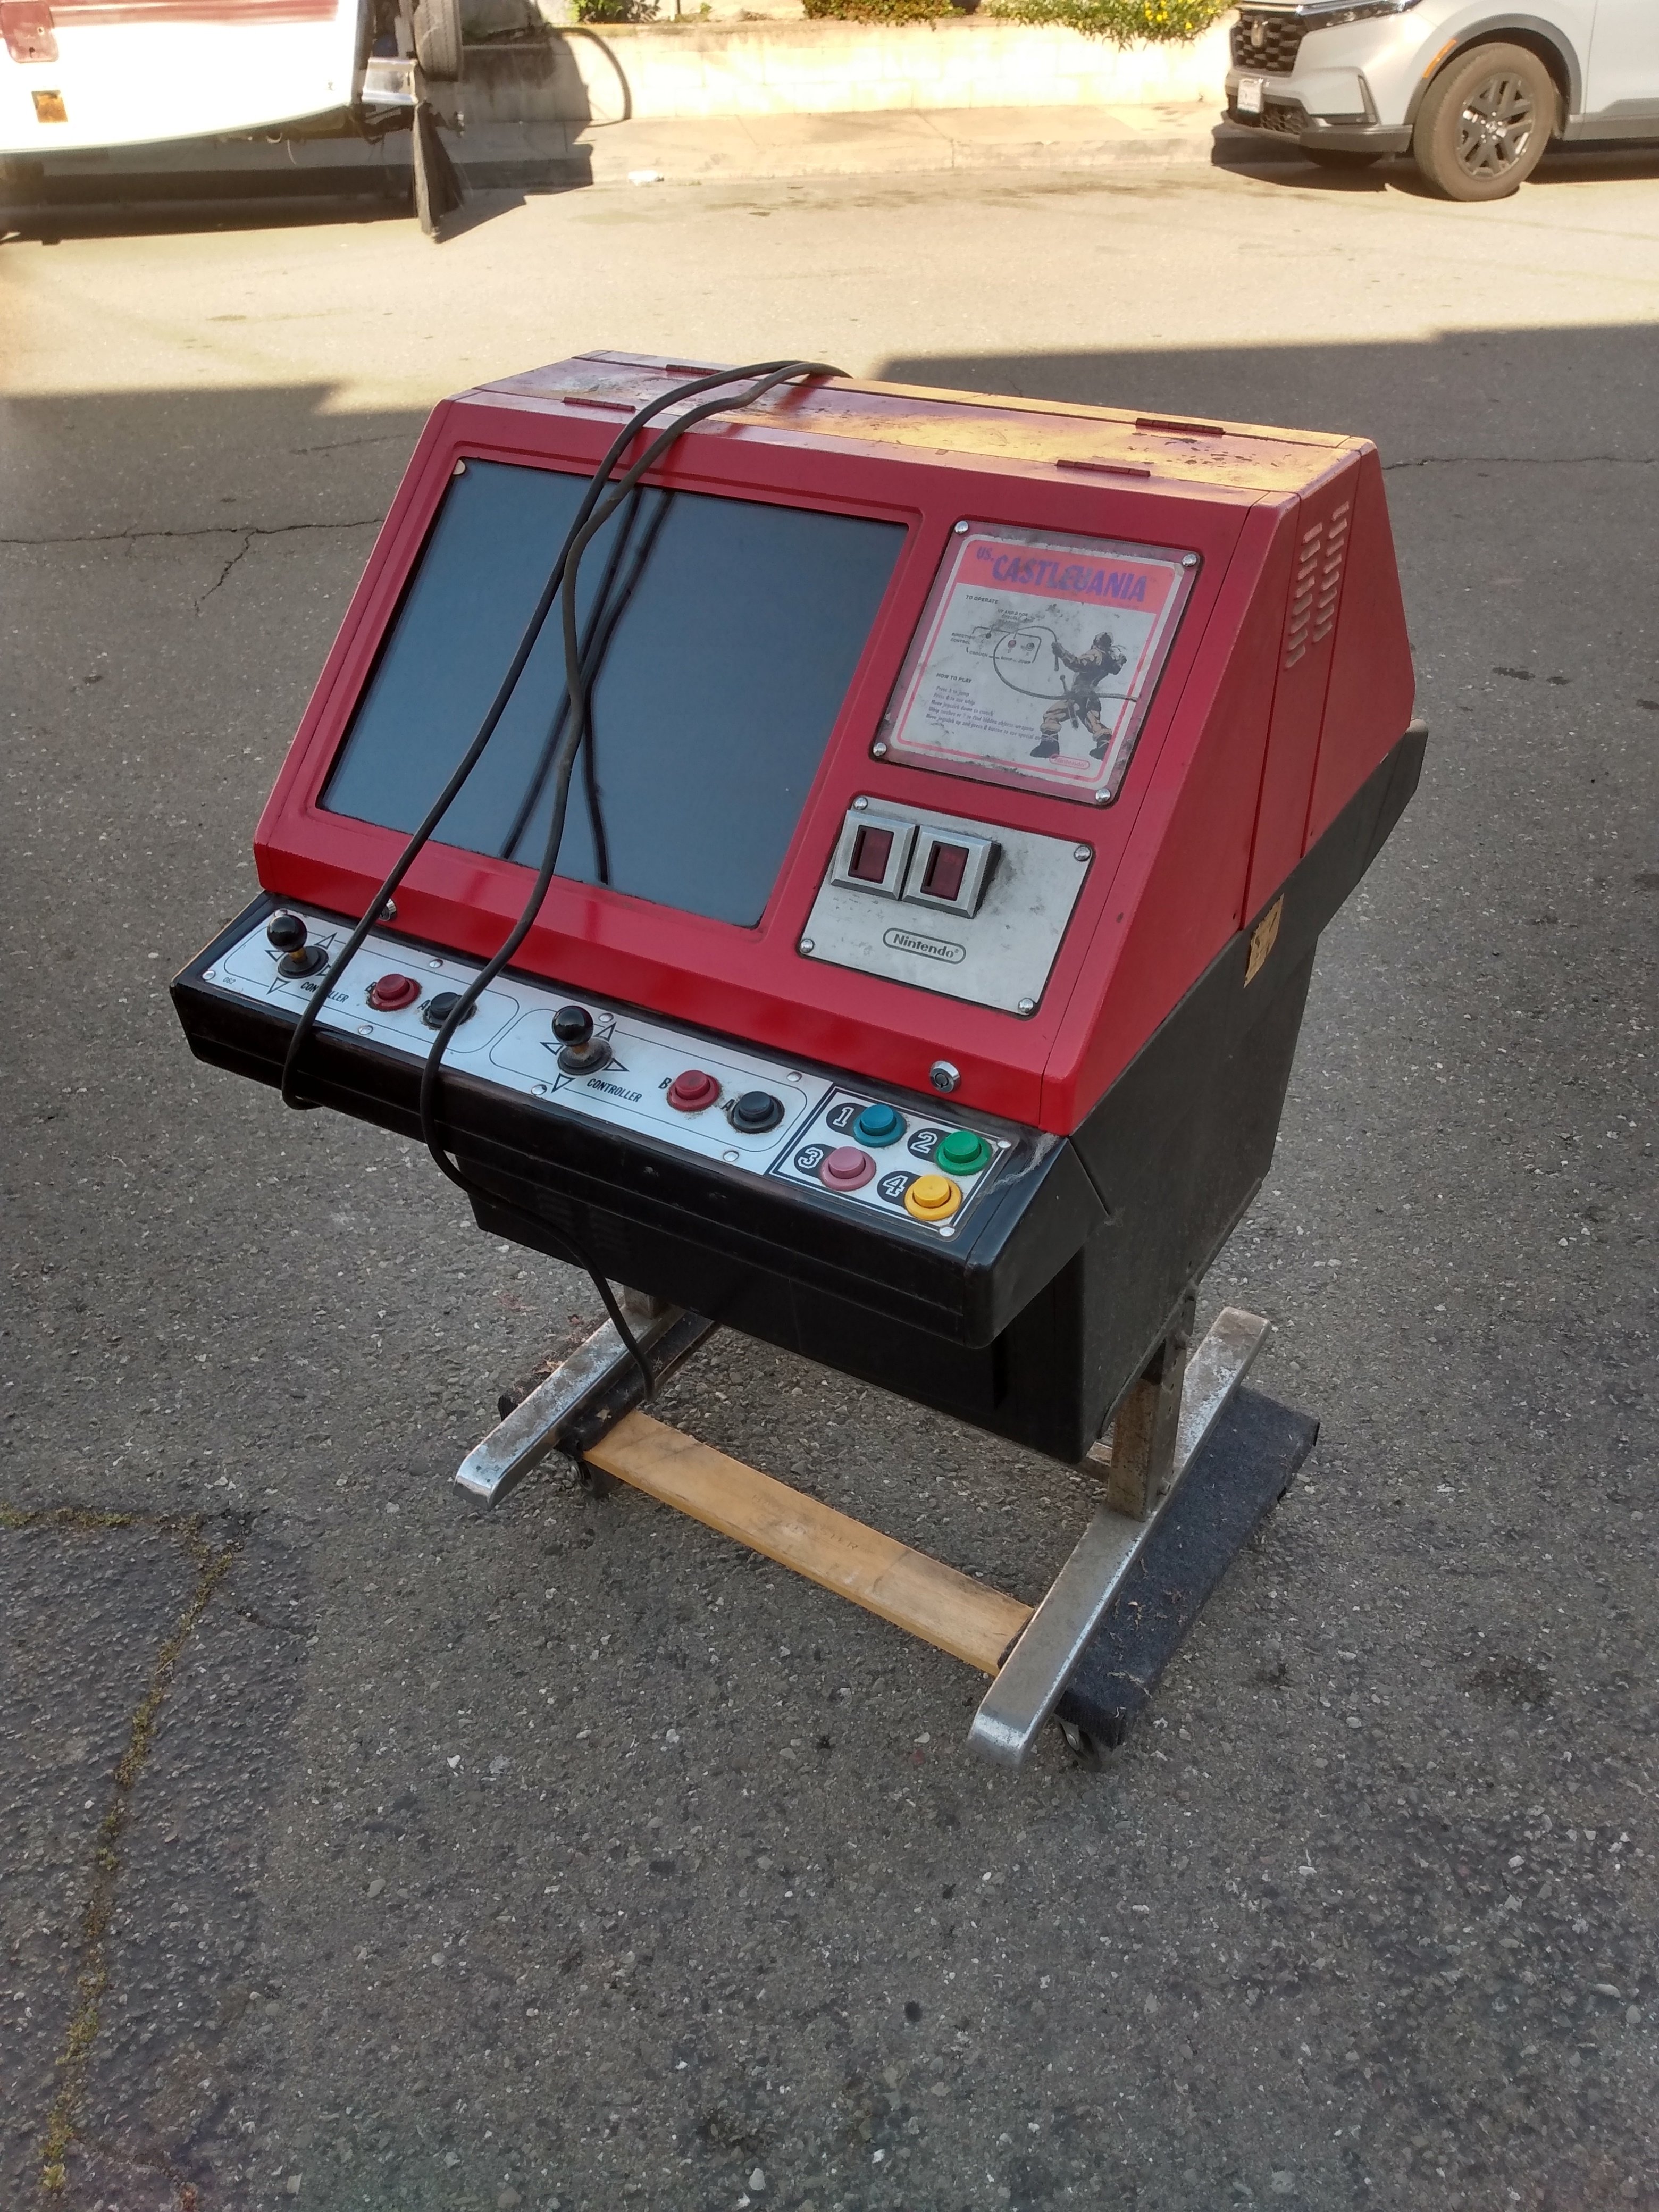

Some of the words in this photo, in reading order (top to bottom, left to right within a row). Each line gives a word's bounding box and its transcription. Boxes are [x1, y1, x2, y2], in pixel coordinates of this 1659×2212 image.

[300, 982, 349, 1003] CONLLER
[417, 999, 431, 1010] A
[587, 1077, 643, 1104] CONTROLLER
[658, 1077, 671, 1090] B
[720, 1098, 736, 1111] A
[833, 1107, 854, 1127] 1
[910, 1132, 939, 1154] 2
[798, 1147, 824, 1170] 3
[882, 1175, 909, 1198] 4
